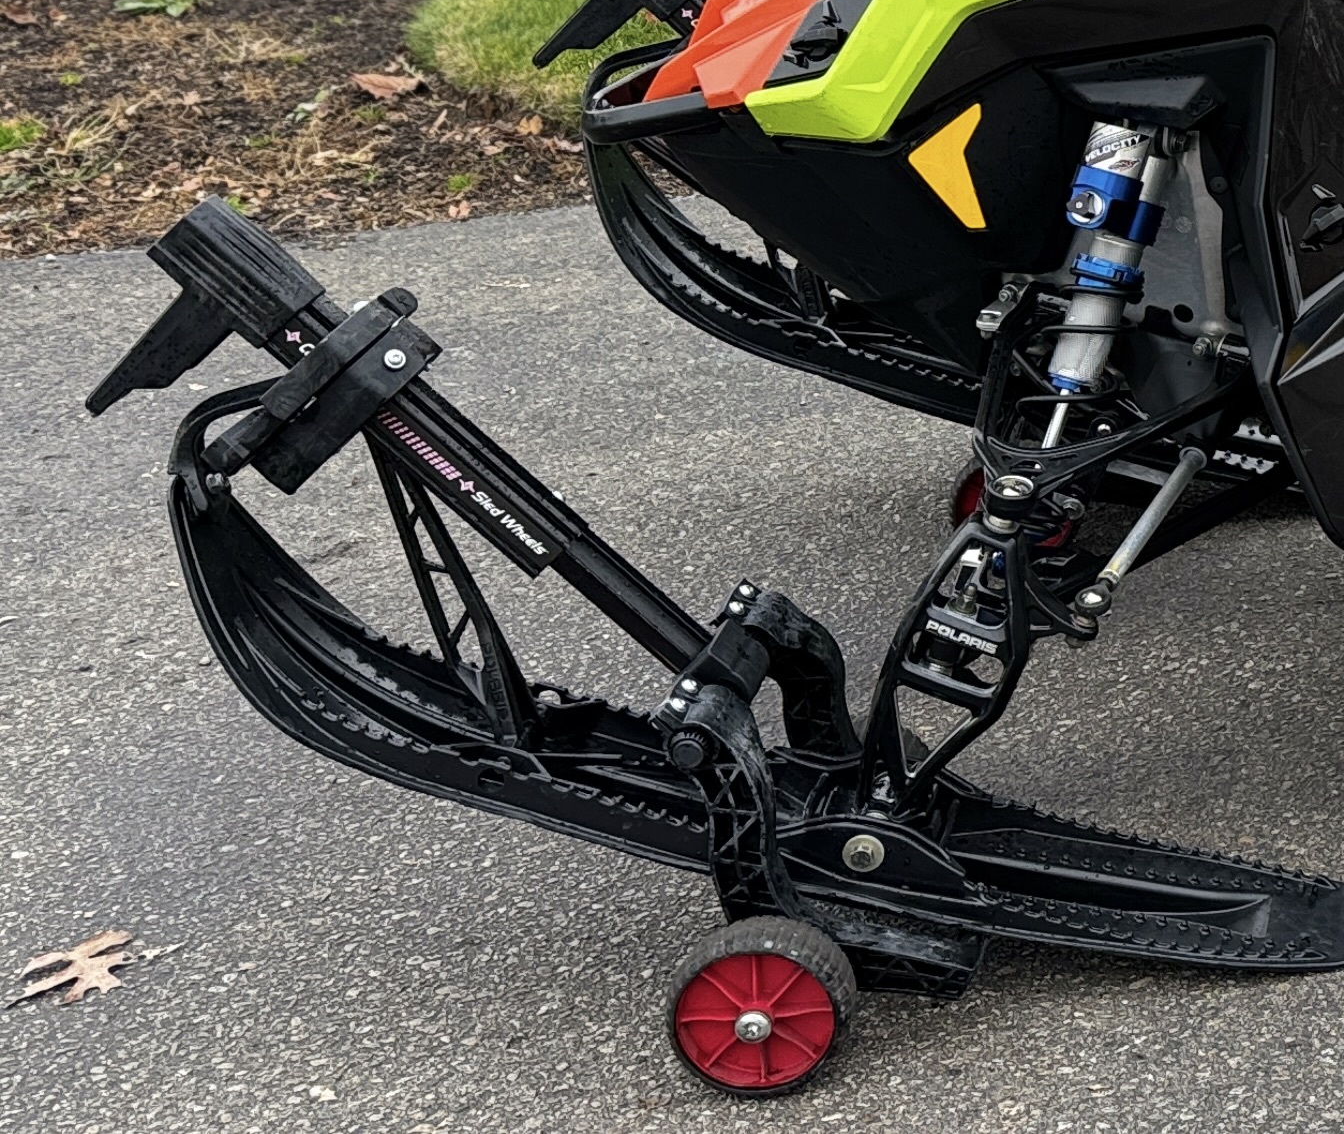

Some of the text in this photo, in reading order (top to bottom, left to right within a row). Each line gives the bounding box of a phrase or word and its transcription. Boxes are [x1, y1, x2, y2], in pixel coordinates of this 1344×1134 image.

[1085, 134, 1141, 163] VELOCITY
[470, 491, 549, 555] Sled Wheels
[925, 619, 999, 655] POLARIS
